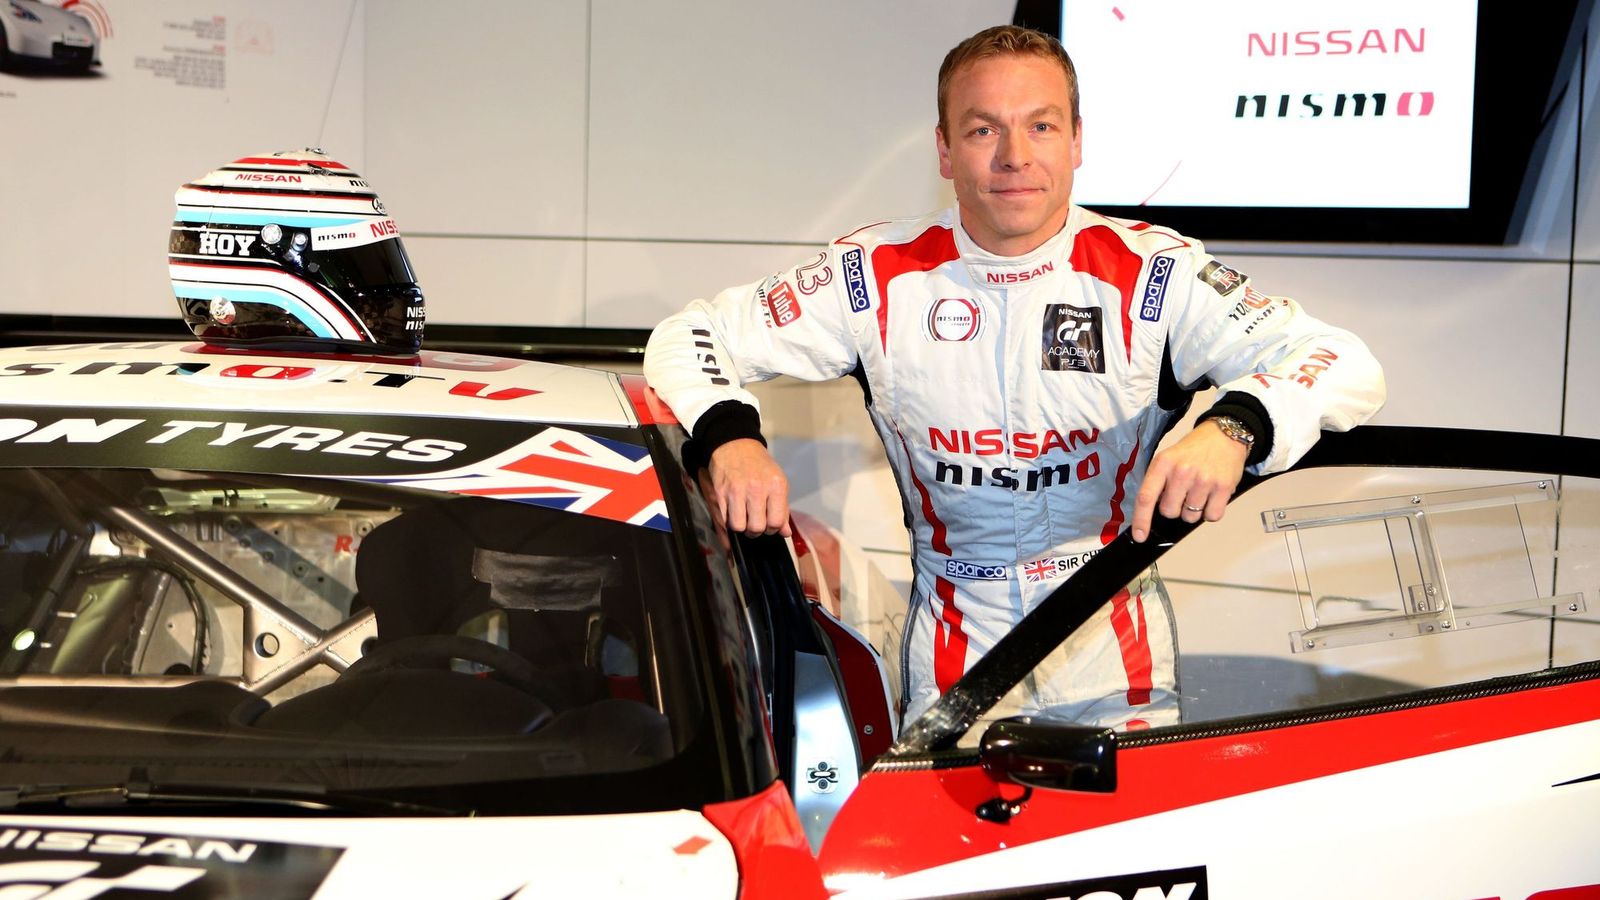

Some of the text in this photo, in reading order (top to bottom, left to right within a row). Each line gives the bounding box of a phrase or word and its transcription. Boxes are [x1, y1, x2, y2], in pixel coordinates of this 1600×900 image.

[1248, 28, 1425, 56] NISSAN
[1235, 92, 1434, 118] nismo
[235, 173, 302, 183] NISSAN
[199, 232, 256, 256] HOY
[318, 232, 356, 241] nismo
[987, 261, 1054, 283] NISSAN
[771, 284, 795, 324] Tube
[1058, 308, 1092, 318] NISSAN
[1048, 346, 1100, 358] ACADEMY
[1061, 359, 1086, 367] PS3
[145, 420, 467, 462] TYRES
[928, 427, 1100, 459] NISSAN
[936, 452, 1101, 492] nismo
[947, 560, 1006, 579] sparco
[1058, 557, 1079, 571] SIR
